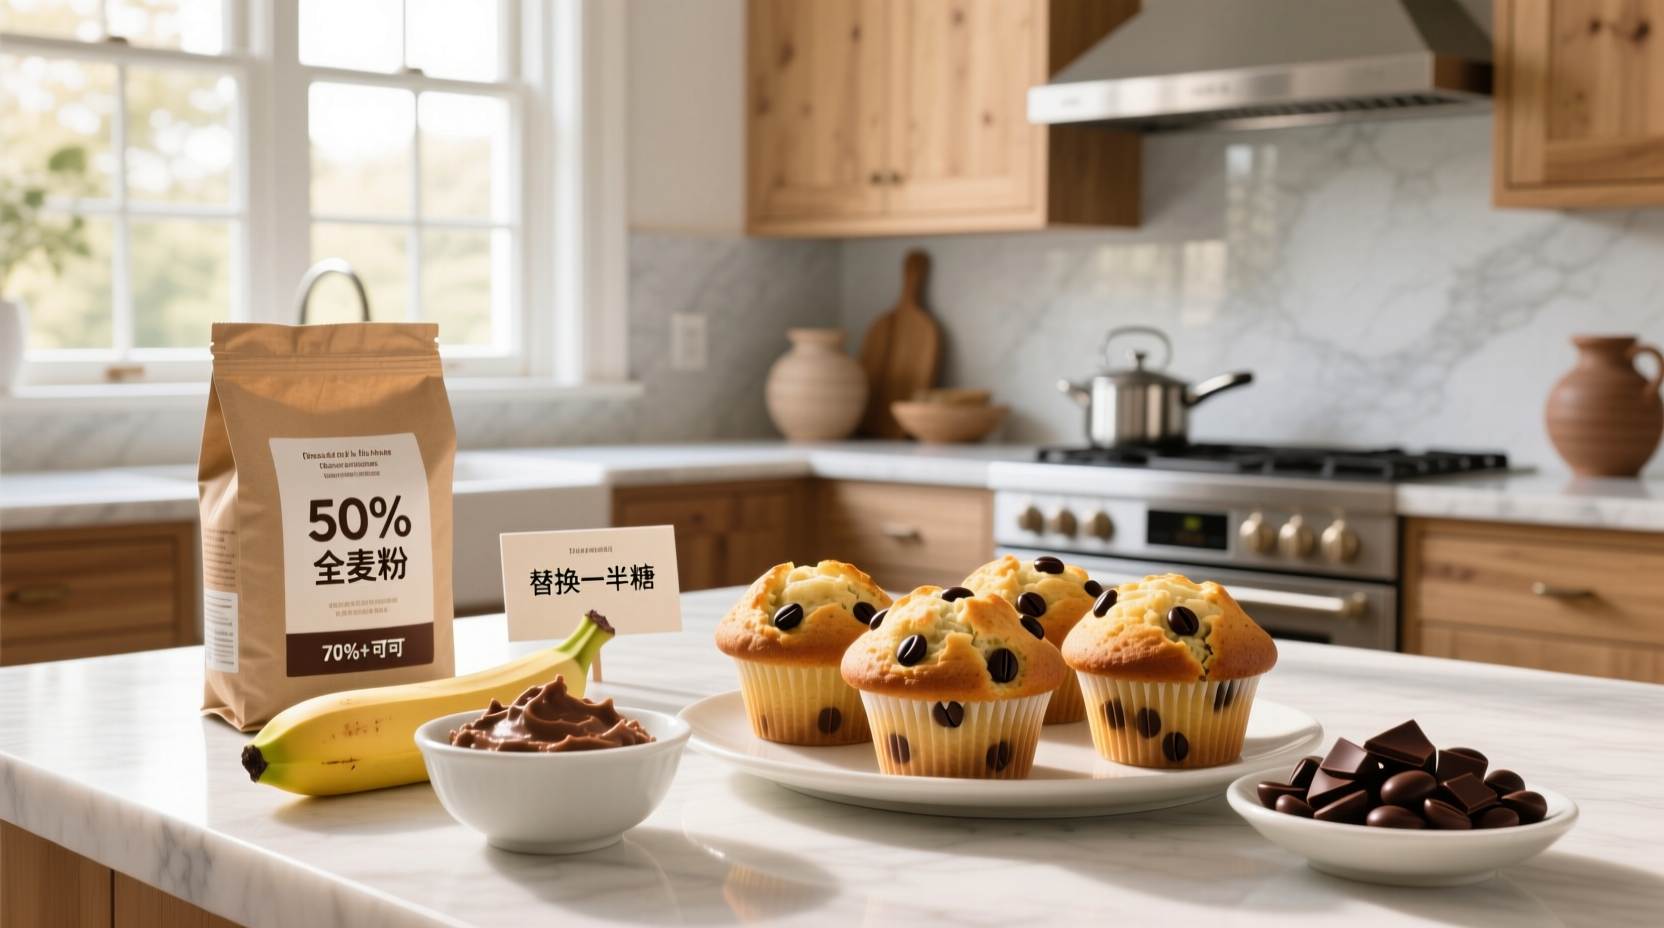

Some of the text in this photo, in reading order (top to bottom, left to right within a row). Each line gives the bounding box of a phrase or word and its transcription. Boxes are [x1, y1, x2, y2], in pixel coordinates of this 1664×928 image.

[308, 495, 412, 542] 50%
[313, 546, 408, 586] 全麦粉
[530, 563, 655, 597] 替换一半糖
